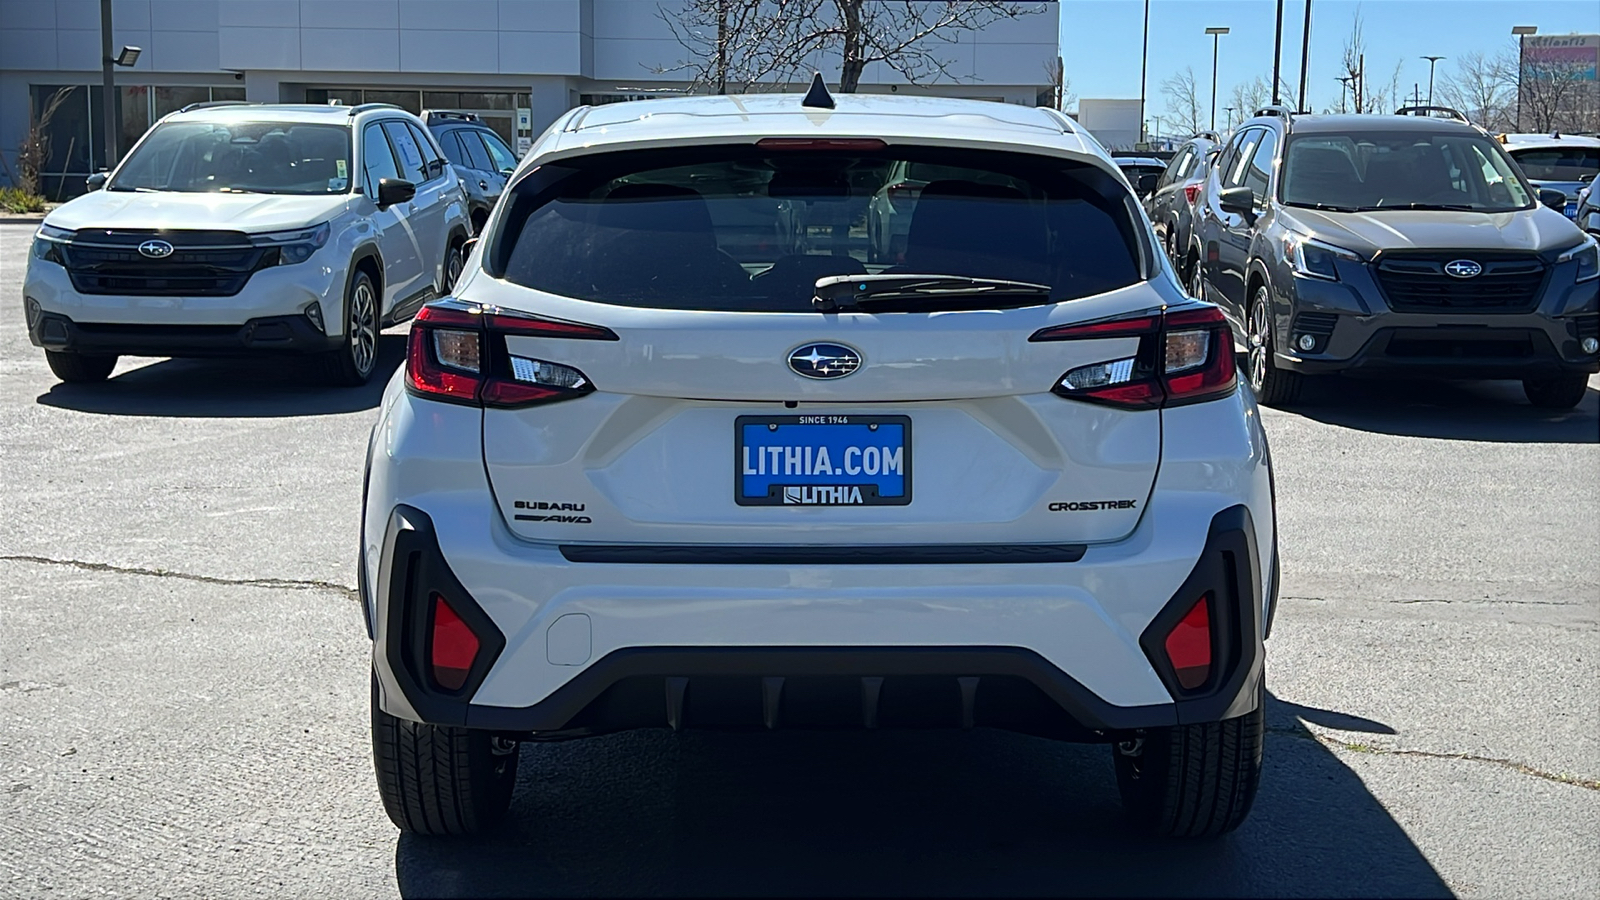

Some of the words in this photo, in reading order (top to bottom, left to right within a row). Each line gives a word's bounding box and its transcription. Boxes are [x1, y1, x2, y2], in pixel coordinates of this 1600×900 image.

[799, 416, 826, 424] SINCE
[828, 416, 848, 424] 1946
[742, 446, 904, 476] LITHIA.COM
[801, 486, 863, 504] LITHIA
[514, 500, 585, 511] SUBARU
[1048, 499, 1137, 511] CROSSTREK
[543, 515, 592, 523] AWD
